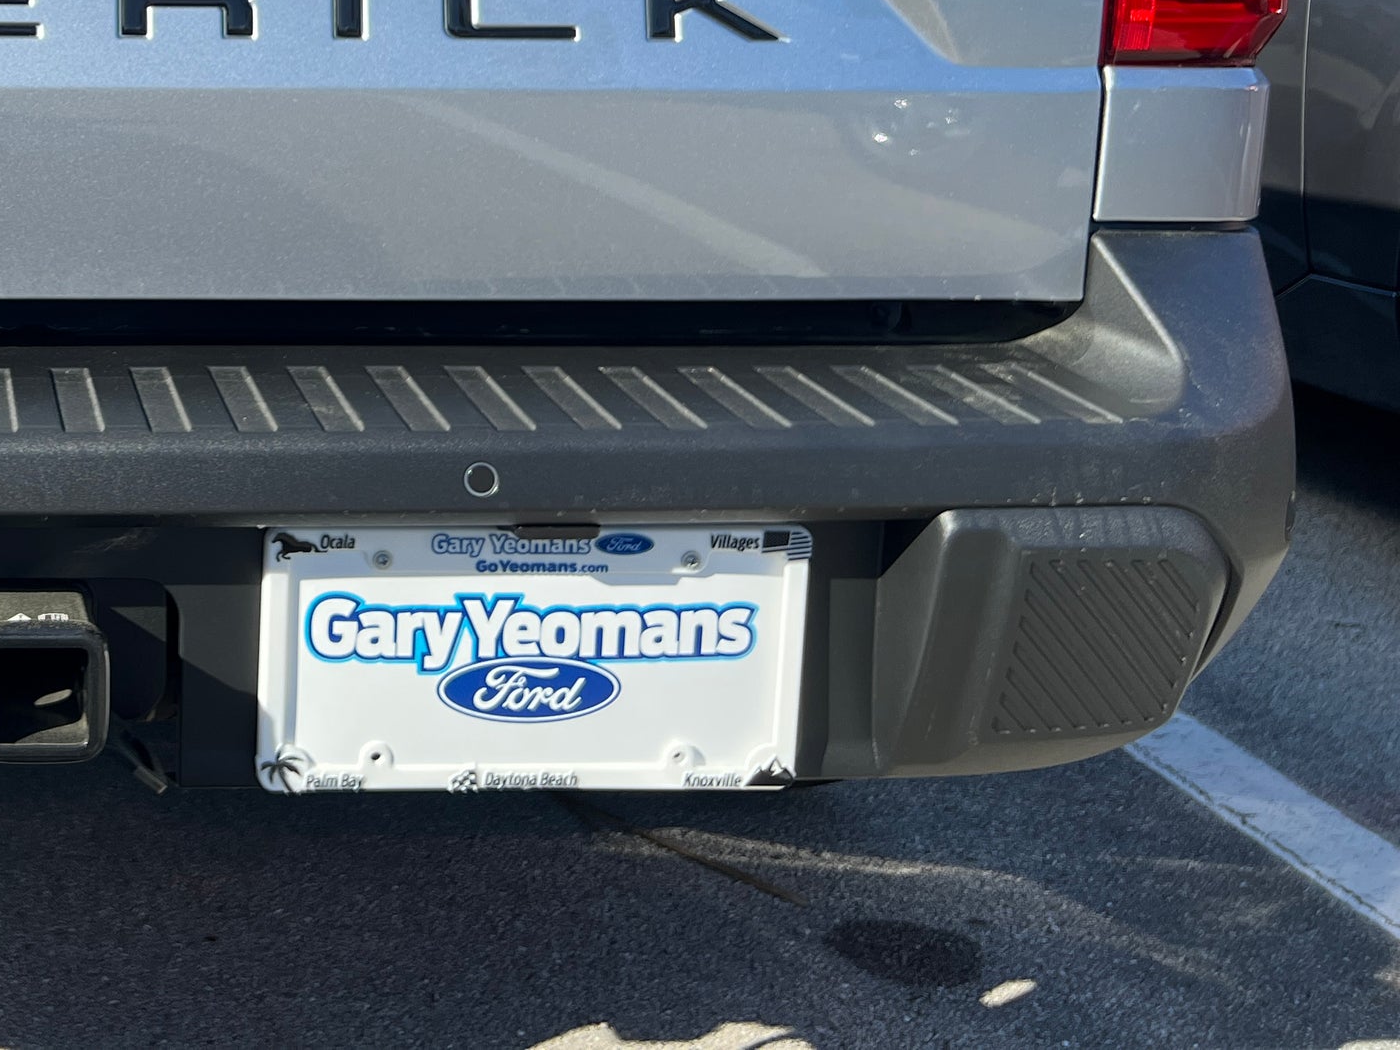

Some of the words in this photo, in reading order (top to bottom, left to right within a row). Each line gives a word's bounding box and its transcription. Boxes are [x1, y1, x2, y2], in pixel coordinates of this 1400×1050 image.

[320, 533, 356, 550] Ocala
[431, 533, 485, 557] Gary
[489, 534, 593, 555] Yeomans
[606, 536, 642, 551] Ford
[710, 534, 760, 552] Villages
[472, 664, 587, 711] Ford
[305, 770, 338, 788] Palm
[340, 770, 364, 791] Bay
[484, 771, 538, 790] Daytona
[539, 771, 577, 787] Beach
[683, 772, 742, 788] Knoxville
